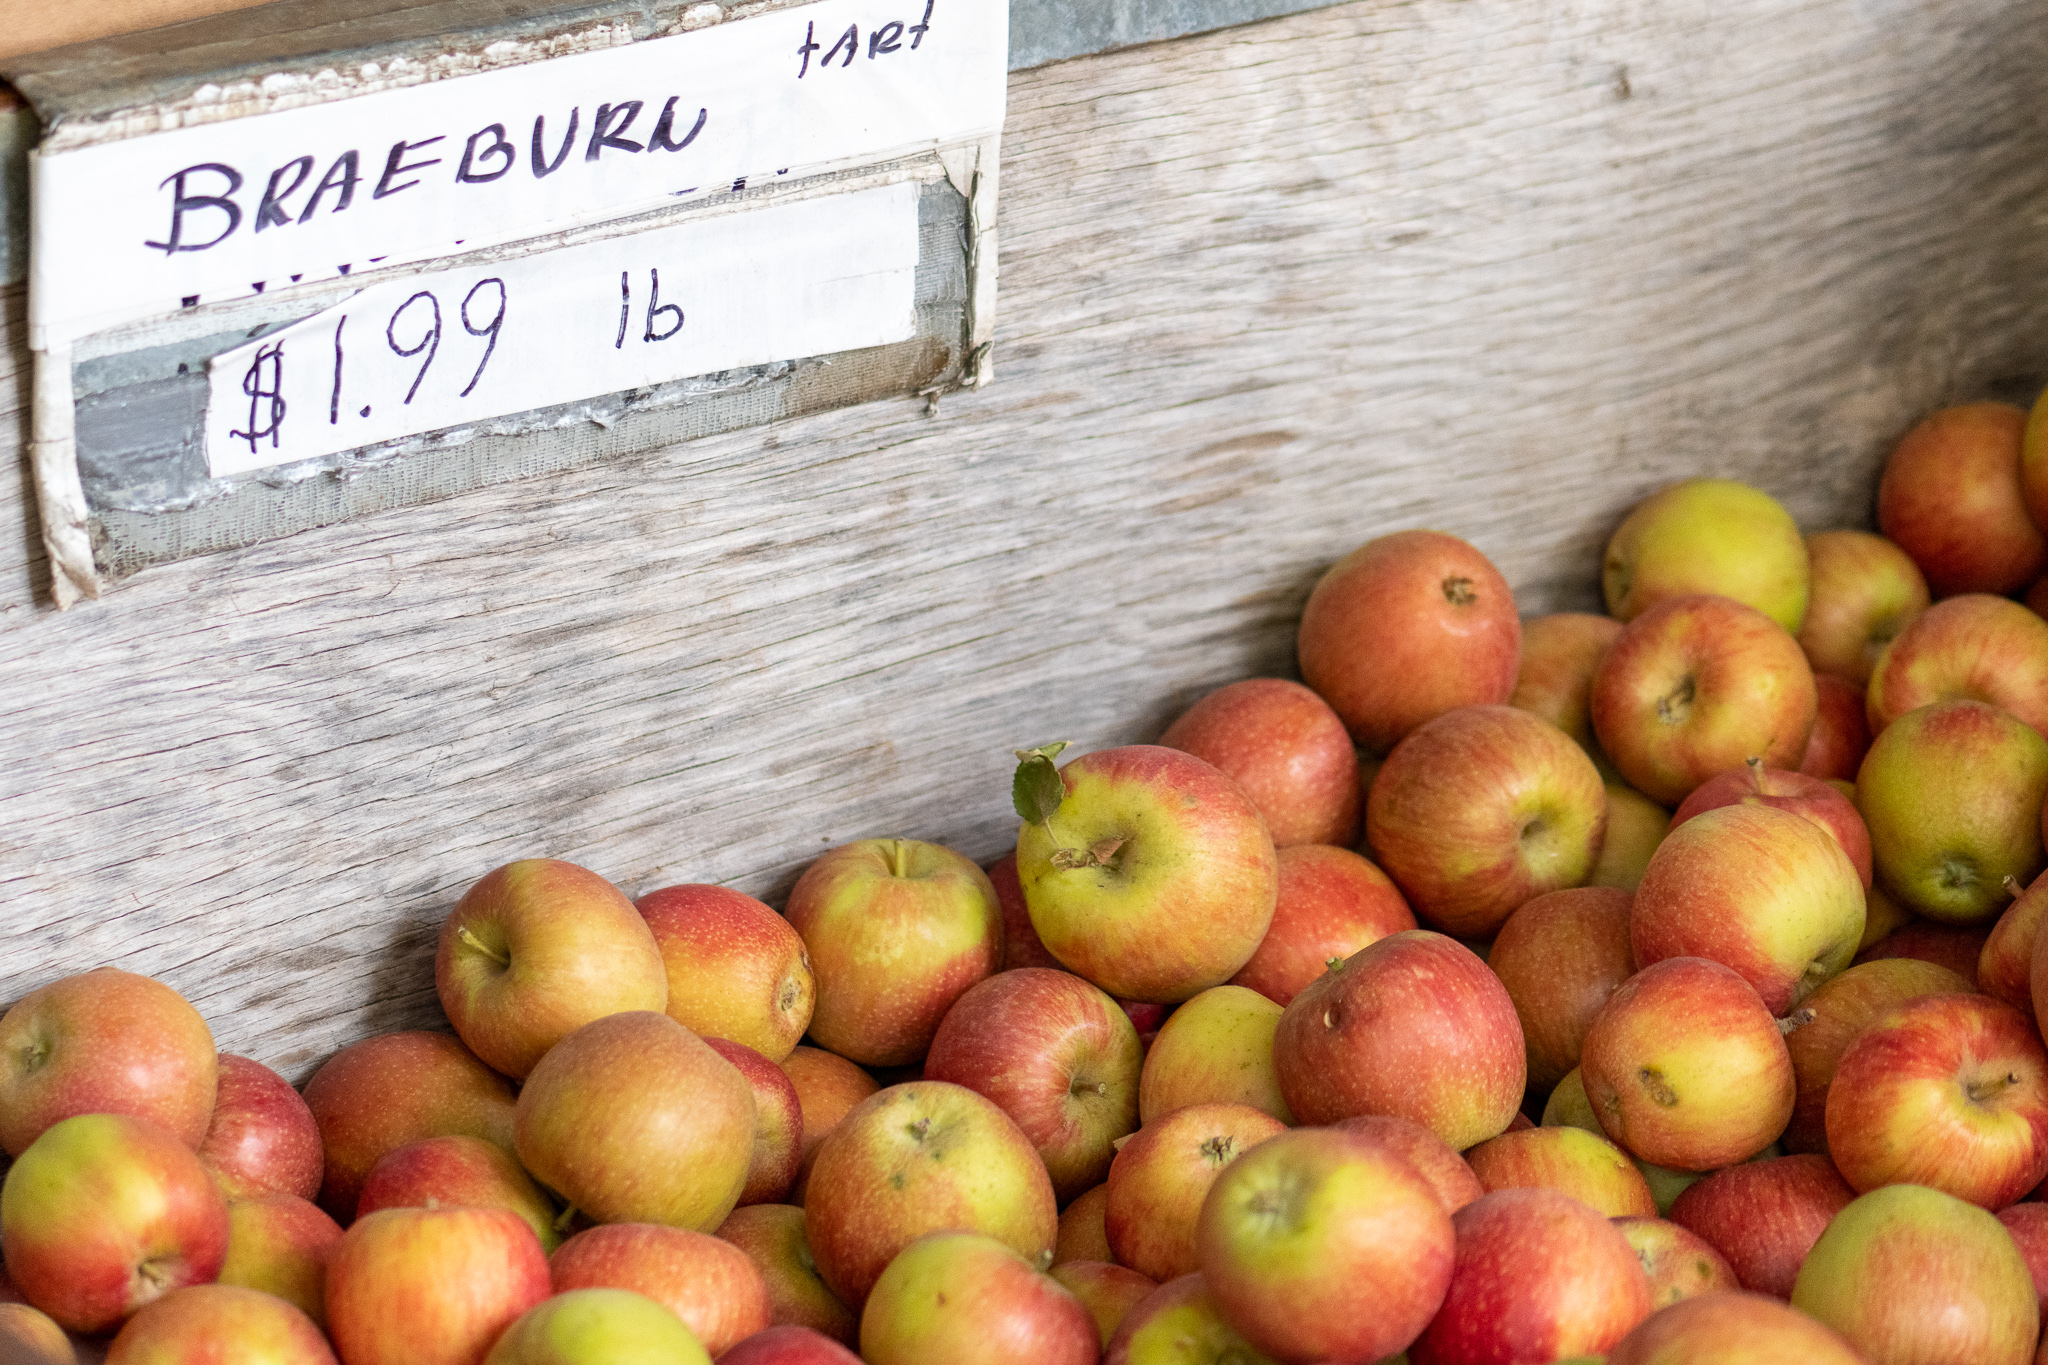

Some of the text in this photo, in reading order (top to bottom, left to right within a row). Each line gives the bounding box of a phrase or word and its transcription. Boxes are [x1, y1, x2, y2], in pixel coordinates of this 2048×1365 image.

[145, 95, 707, 255] BRAEBURN
[229, 267, 686, 454] $1.99 lb
